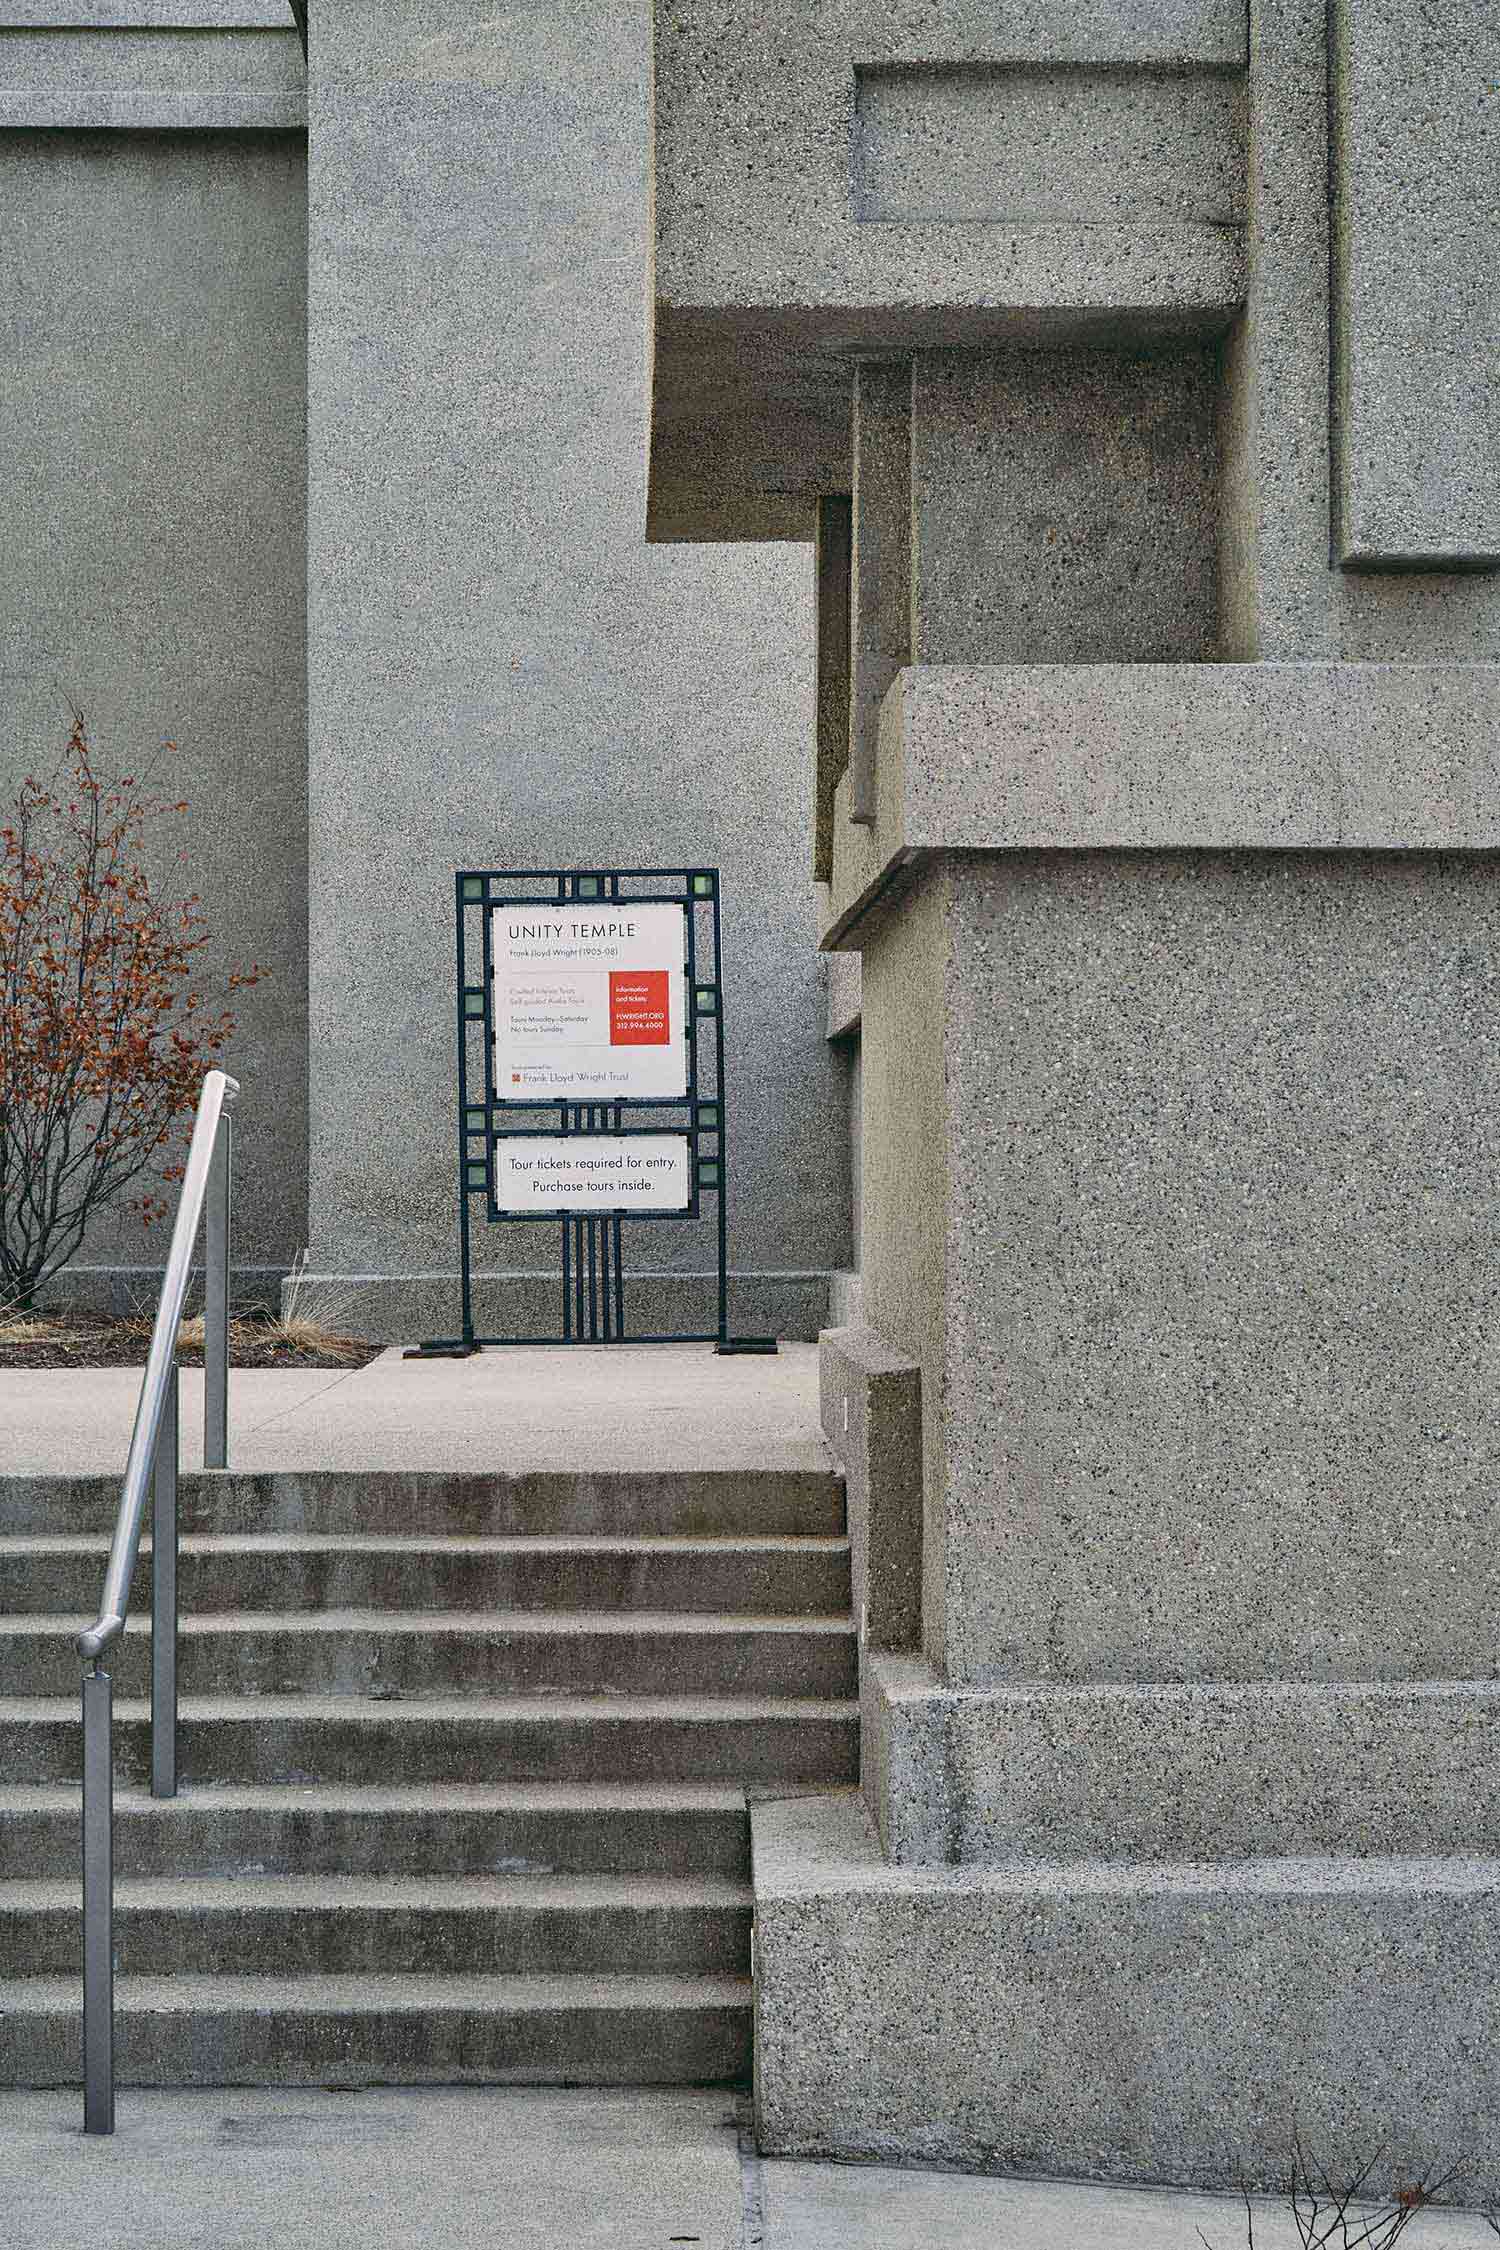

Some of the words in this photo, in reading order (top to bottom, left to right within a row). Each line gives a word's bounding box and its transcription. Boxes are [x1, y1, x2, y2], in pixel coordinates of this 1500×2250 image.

[509, 924, 562, 938] UNITY
[571, 923, 635, 937] TEMPLE
[553, 949, 577, 959] Wright
[539, 1025, 564, 1035] Sunday
[523, 1072, 547, 1082] Frank
[550, 1072, 574, 1084] Lloyd
[576, 1072, 607, 1083] Wright
[608, 1072, 629, 1081] Trust
[510, 1158, 533, 1170] Tour
[537, 1158, 572, 1169] tickets
[575, 1156, 623, 1172] required
[627, 1156, 642, 1168] for
[645, 1158, 677, 1170] entry.
[533, 1180, 583, 1192] Purchase
[587, 1181, 614, 1191] tours
[618, 1179, 655, 1191] inside.
